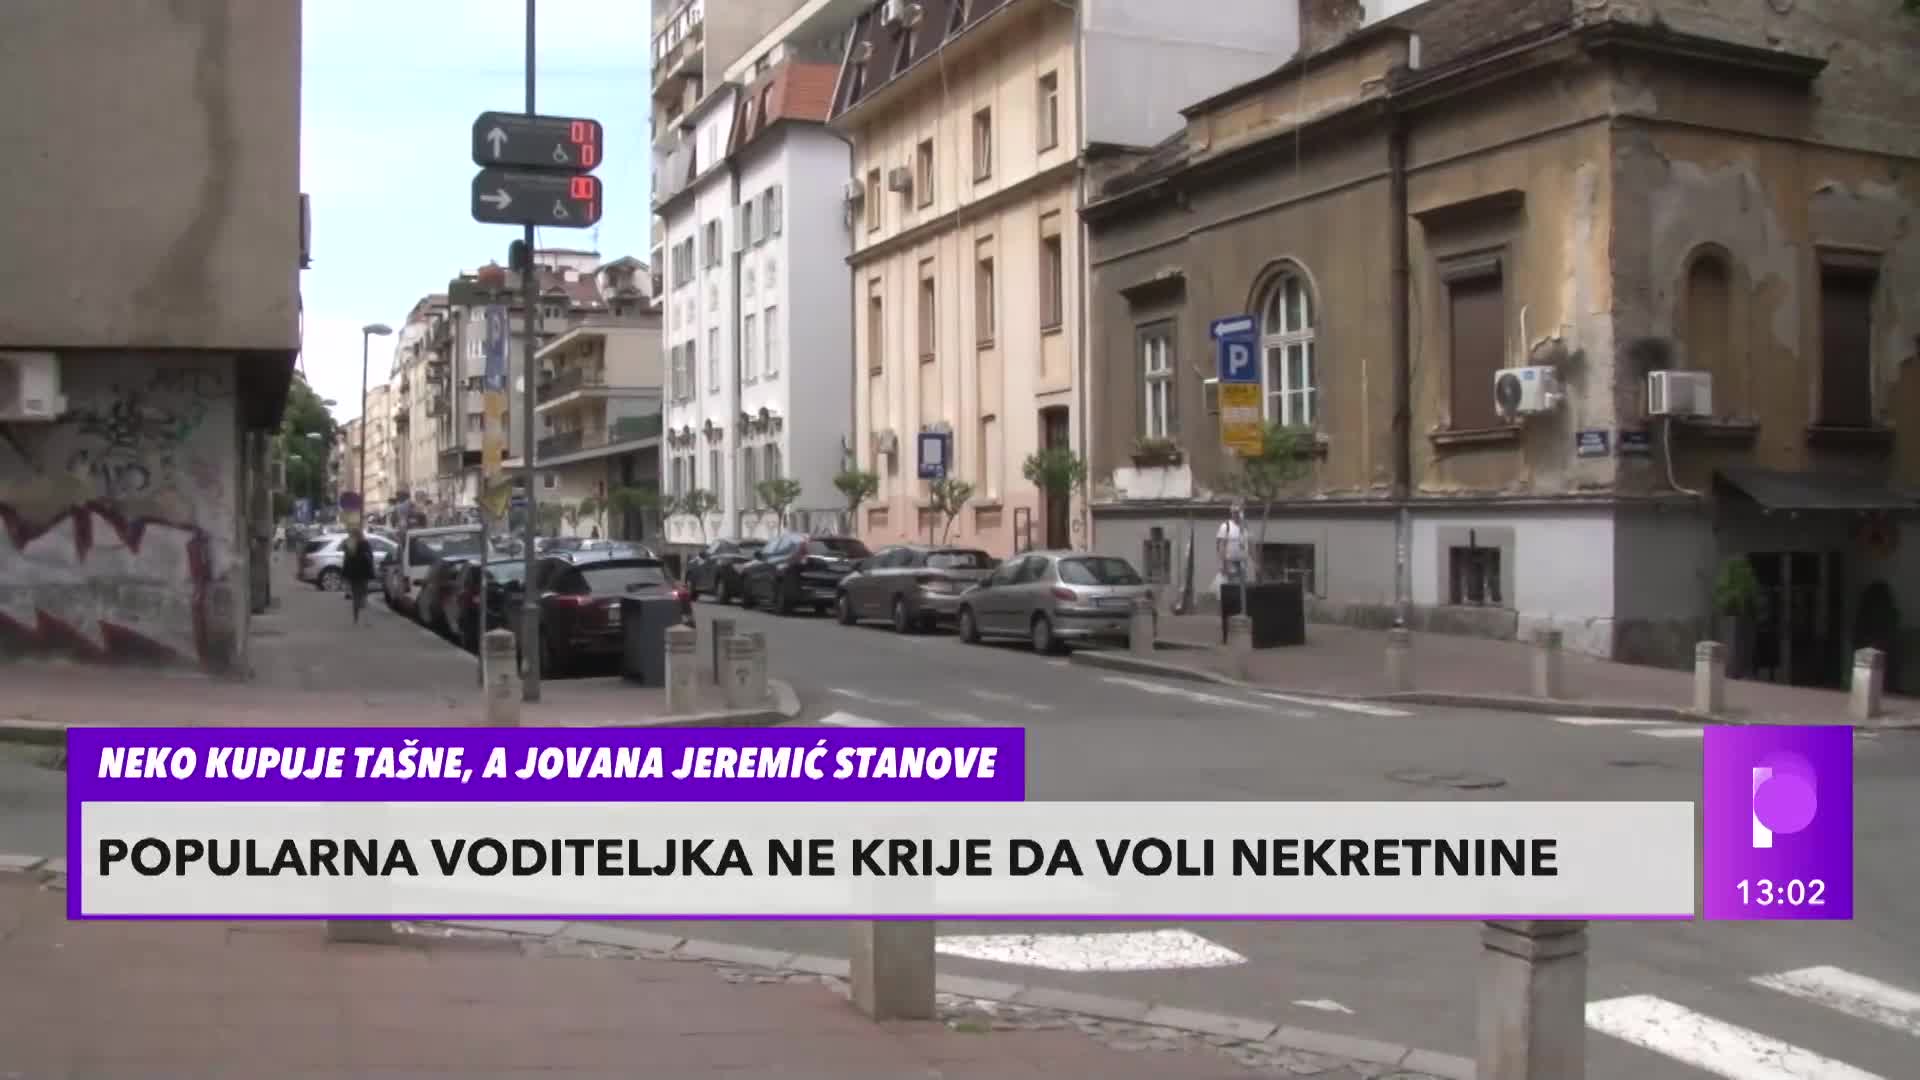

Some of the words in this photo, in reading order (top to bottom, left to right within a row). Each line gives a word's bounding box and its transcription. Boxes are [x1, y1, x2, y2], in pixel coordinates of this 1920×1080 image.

[570, 121, 595, 143] 01
[581, 144, 594, 166] 0
[1228, 343, 1249, 376] P
